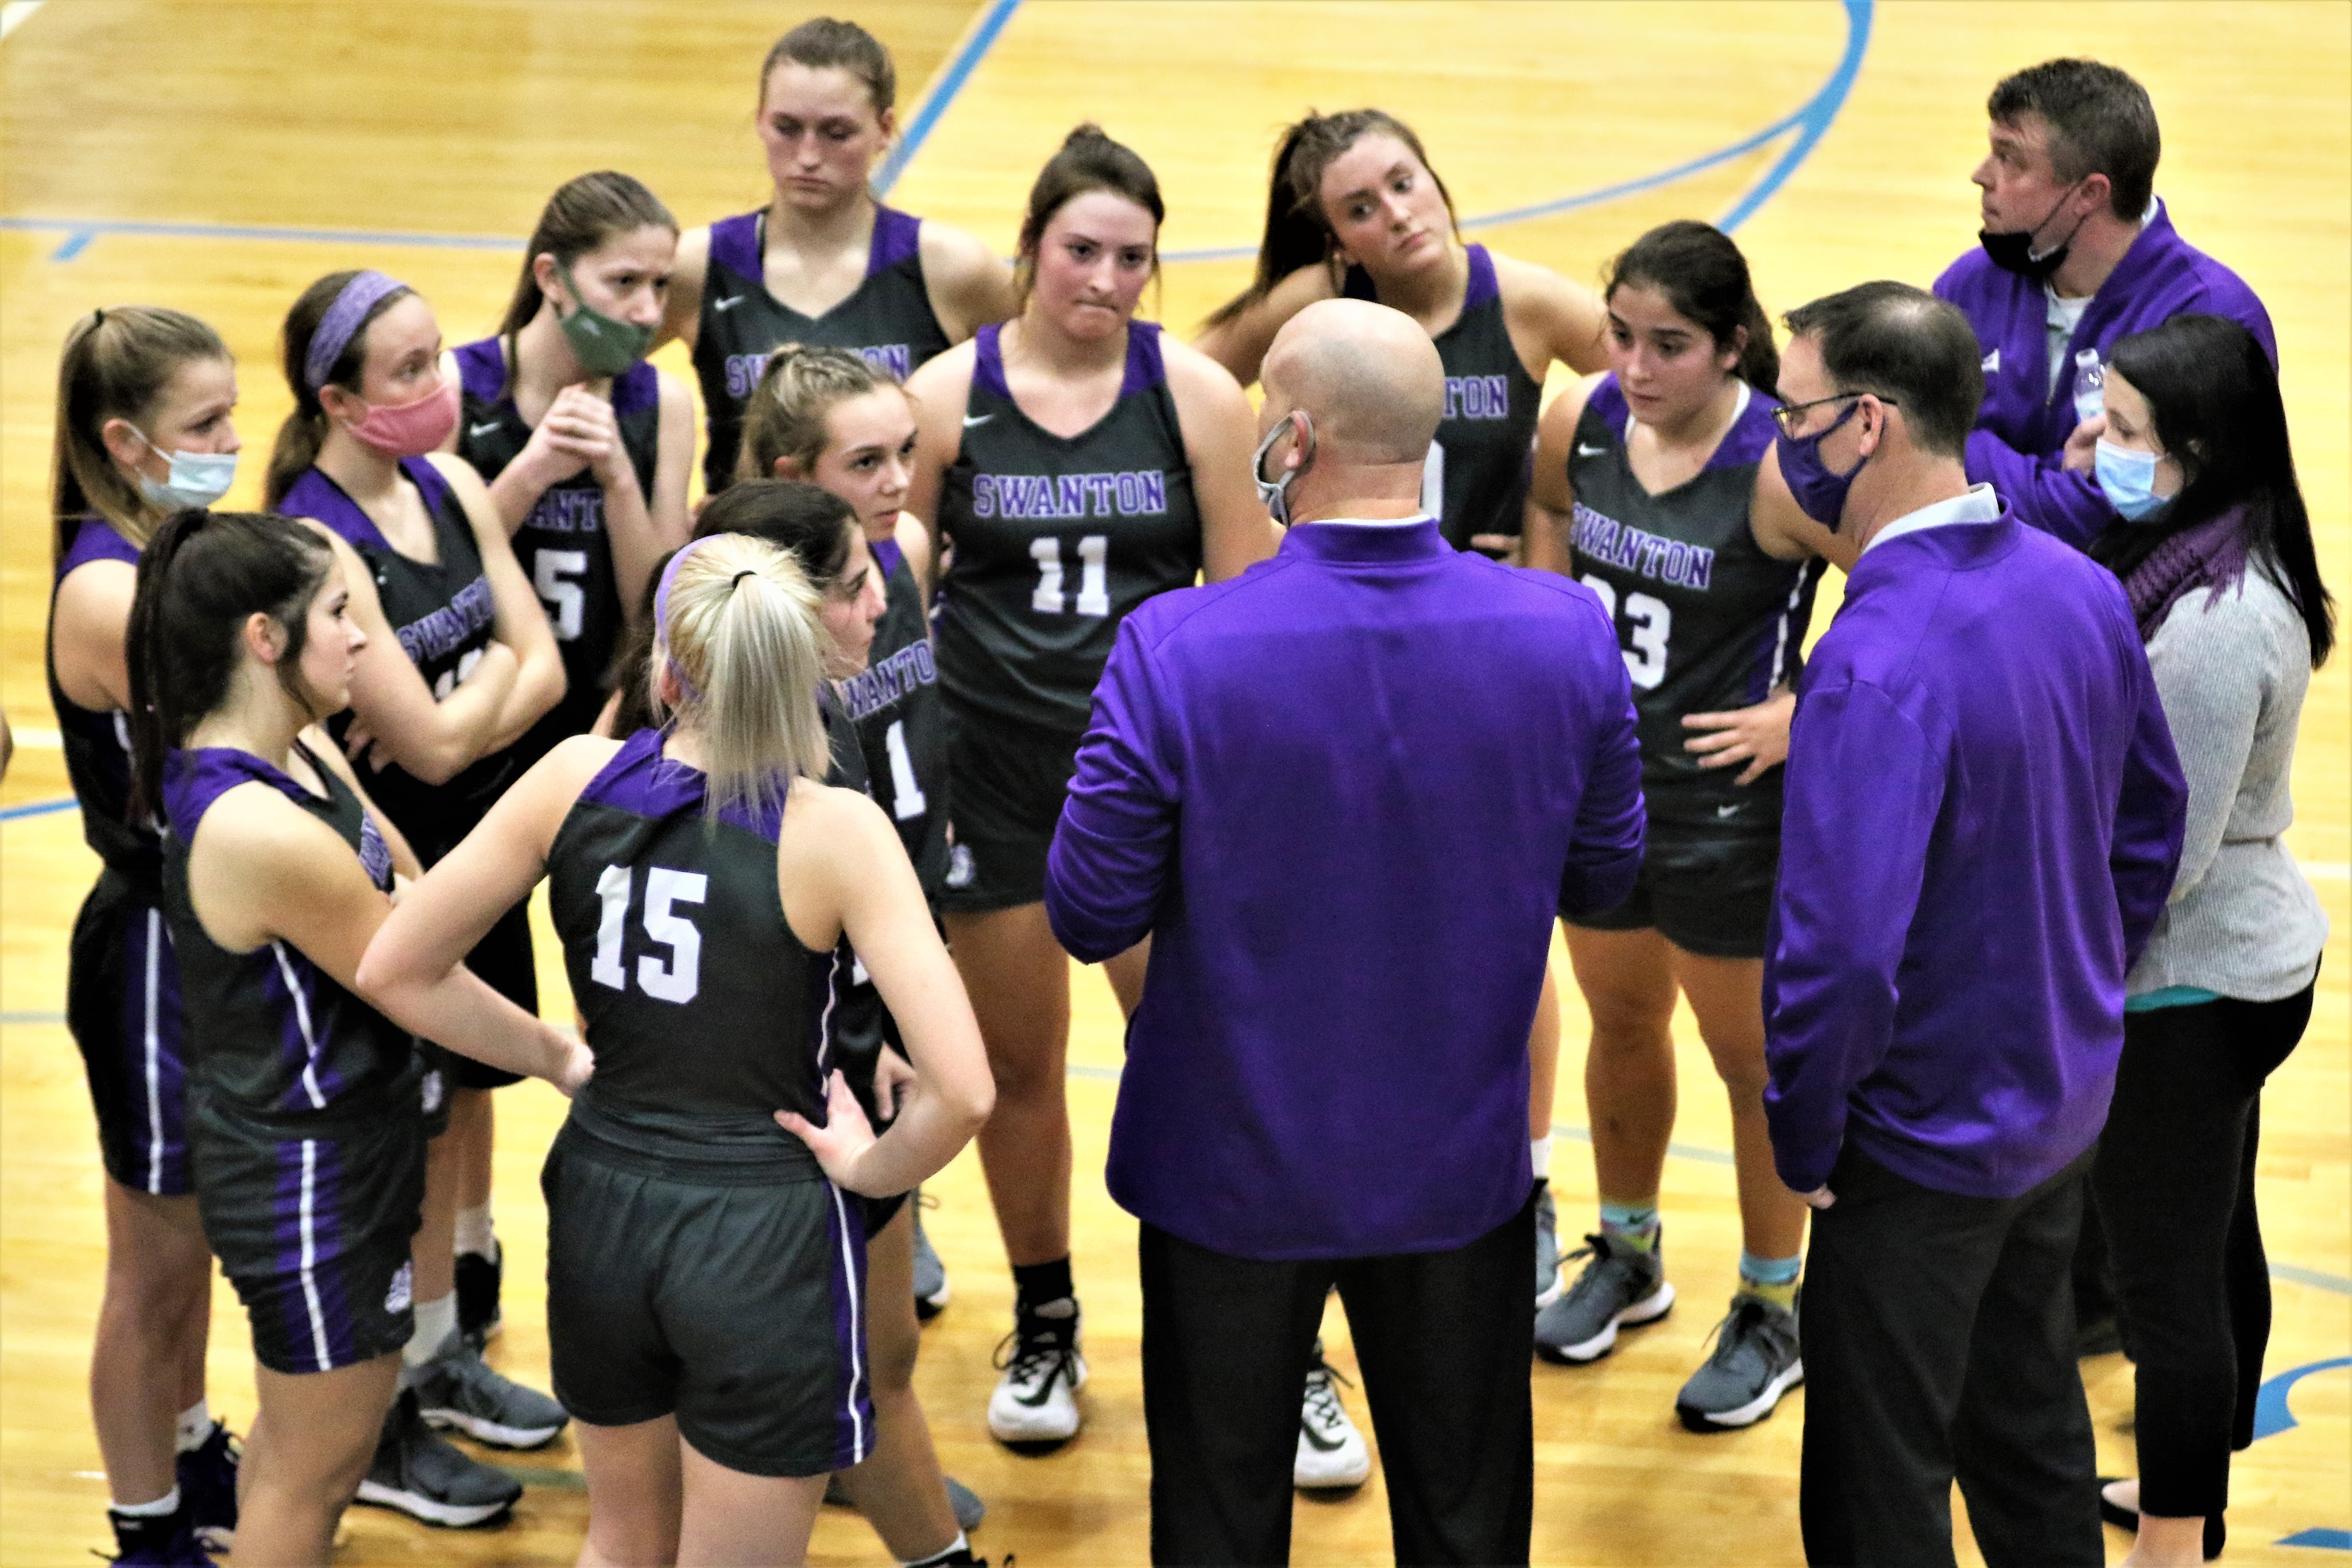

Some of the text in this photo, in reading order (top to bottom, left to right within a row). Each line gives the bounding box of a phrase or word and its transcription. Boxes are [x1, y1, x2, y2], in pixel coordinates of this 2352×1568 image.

[973, 471, 1166, 518] SWANTON
[534, 548, 586, 641] 5
[1030, 535, 1109, 616] 11
[886, 719, 926, 821] 1
[591, 864, 708, 1004] 15
